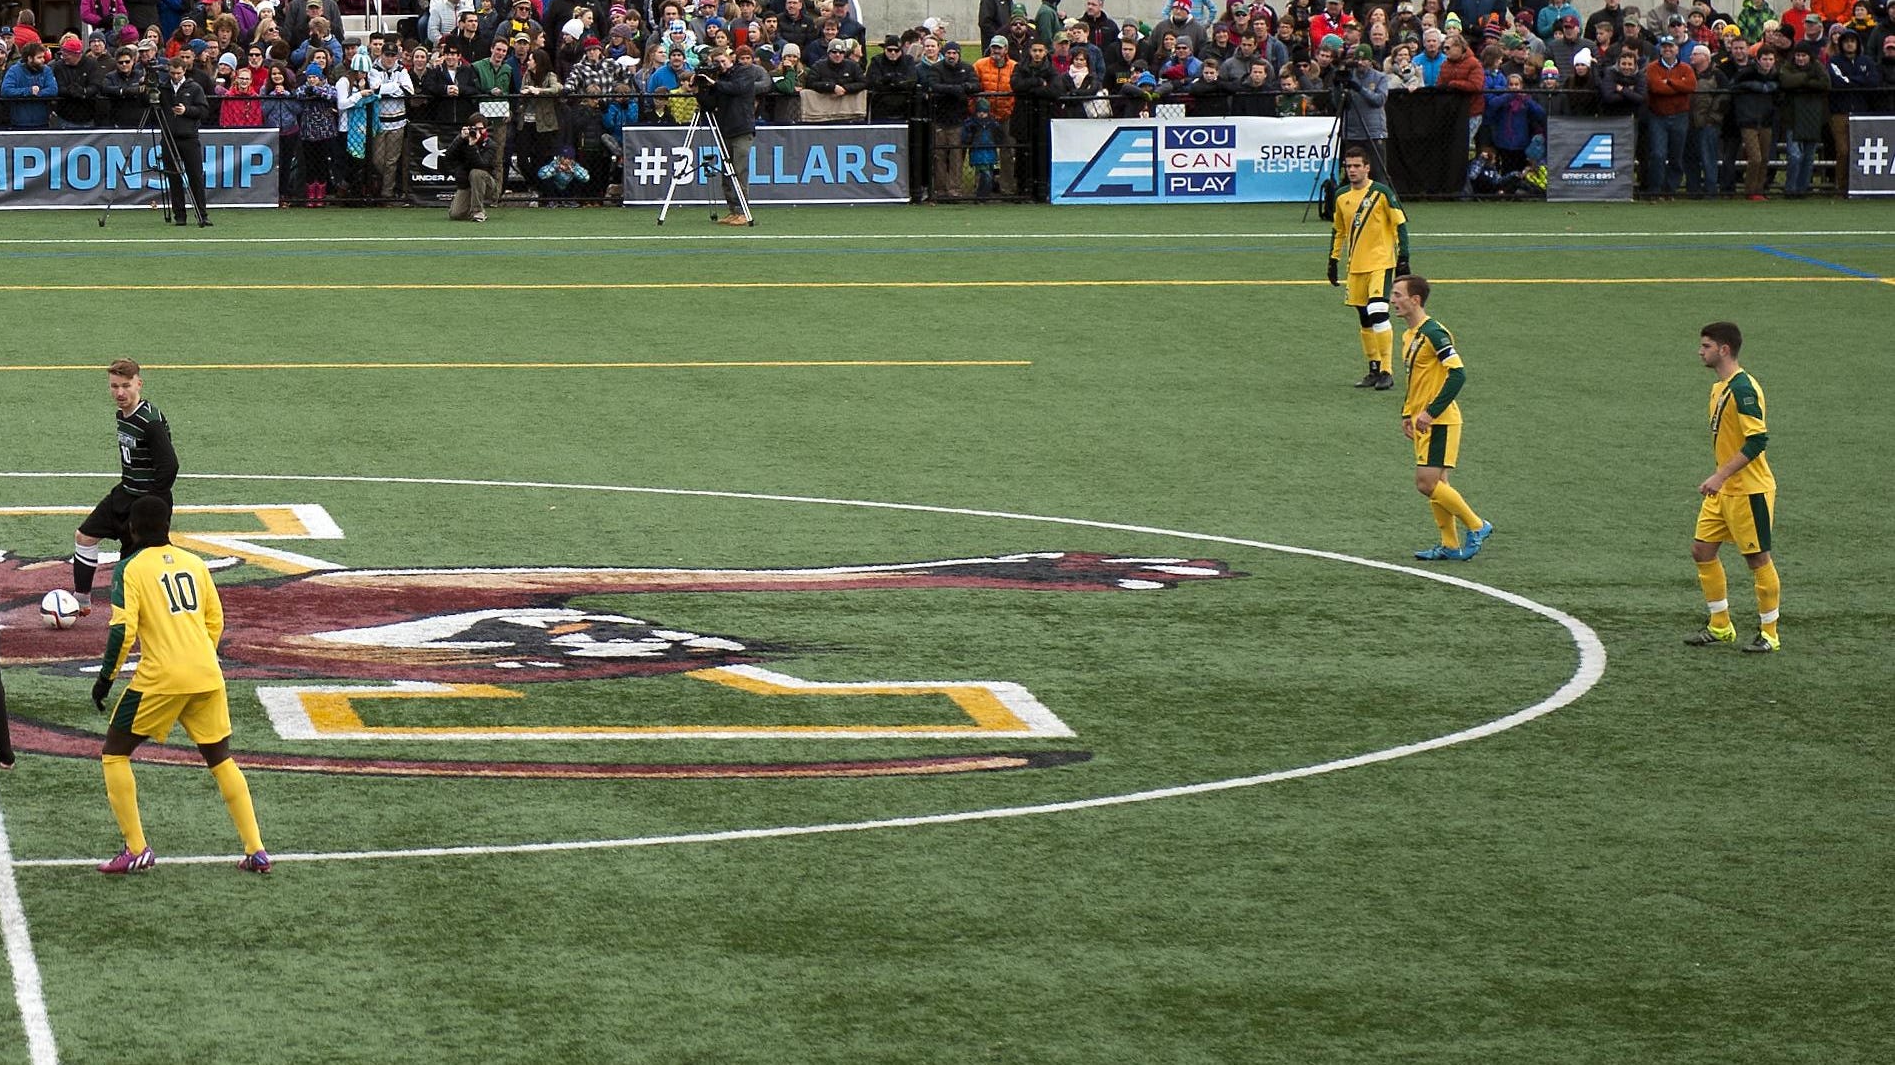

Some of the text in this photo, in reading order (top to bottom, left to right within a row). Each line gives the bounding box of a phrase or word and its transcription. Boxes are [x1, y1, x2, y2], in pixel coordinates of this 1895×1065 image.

[1172, 129, 1229, 145] YOU
[1171, 152, 1231, 168] CAN
[1261, 145, 1331, 160] SPREAD
[634, 144, 898, 185] #3PLLARS
[1254, 159, 1330, 174] RESPECT
[411, 174, 445, 182] UNDER
[1170, 176, 1231, 192] PLAY
[160, 571, 198, 613] 10
